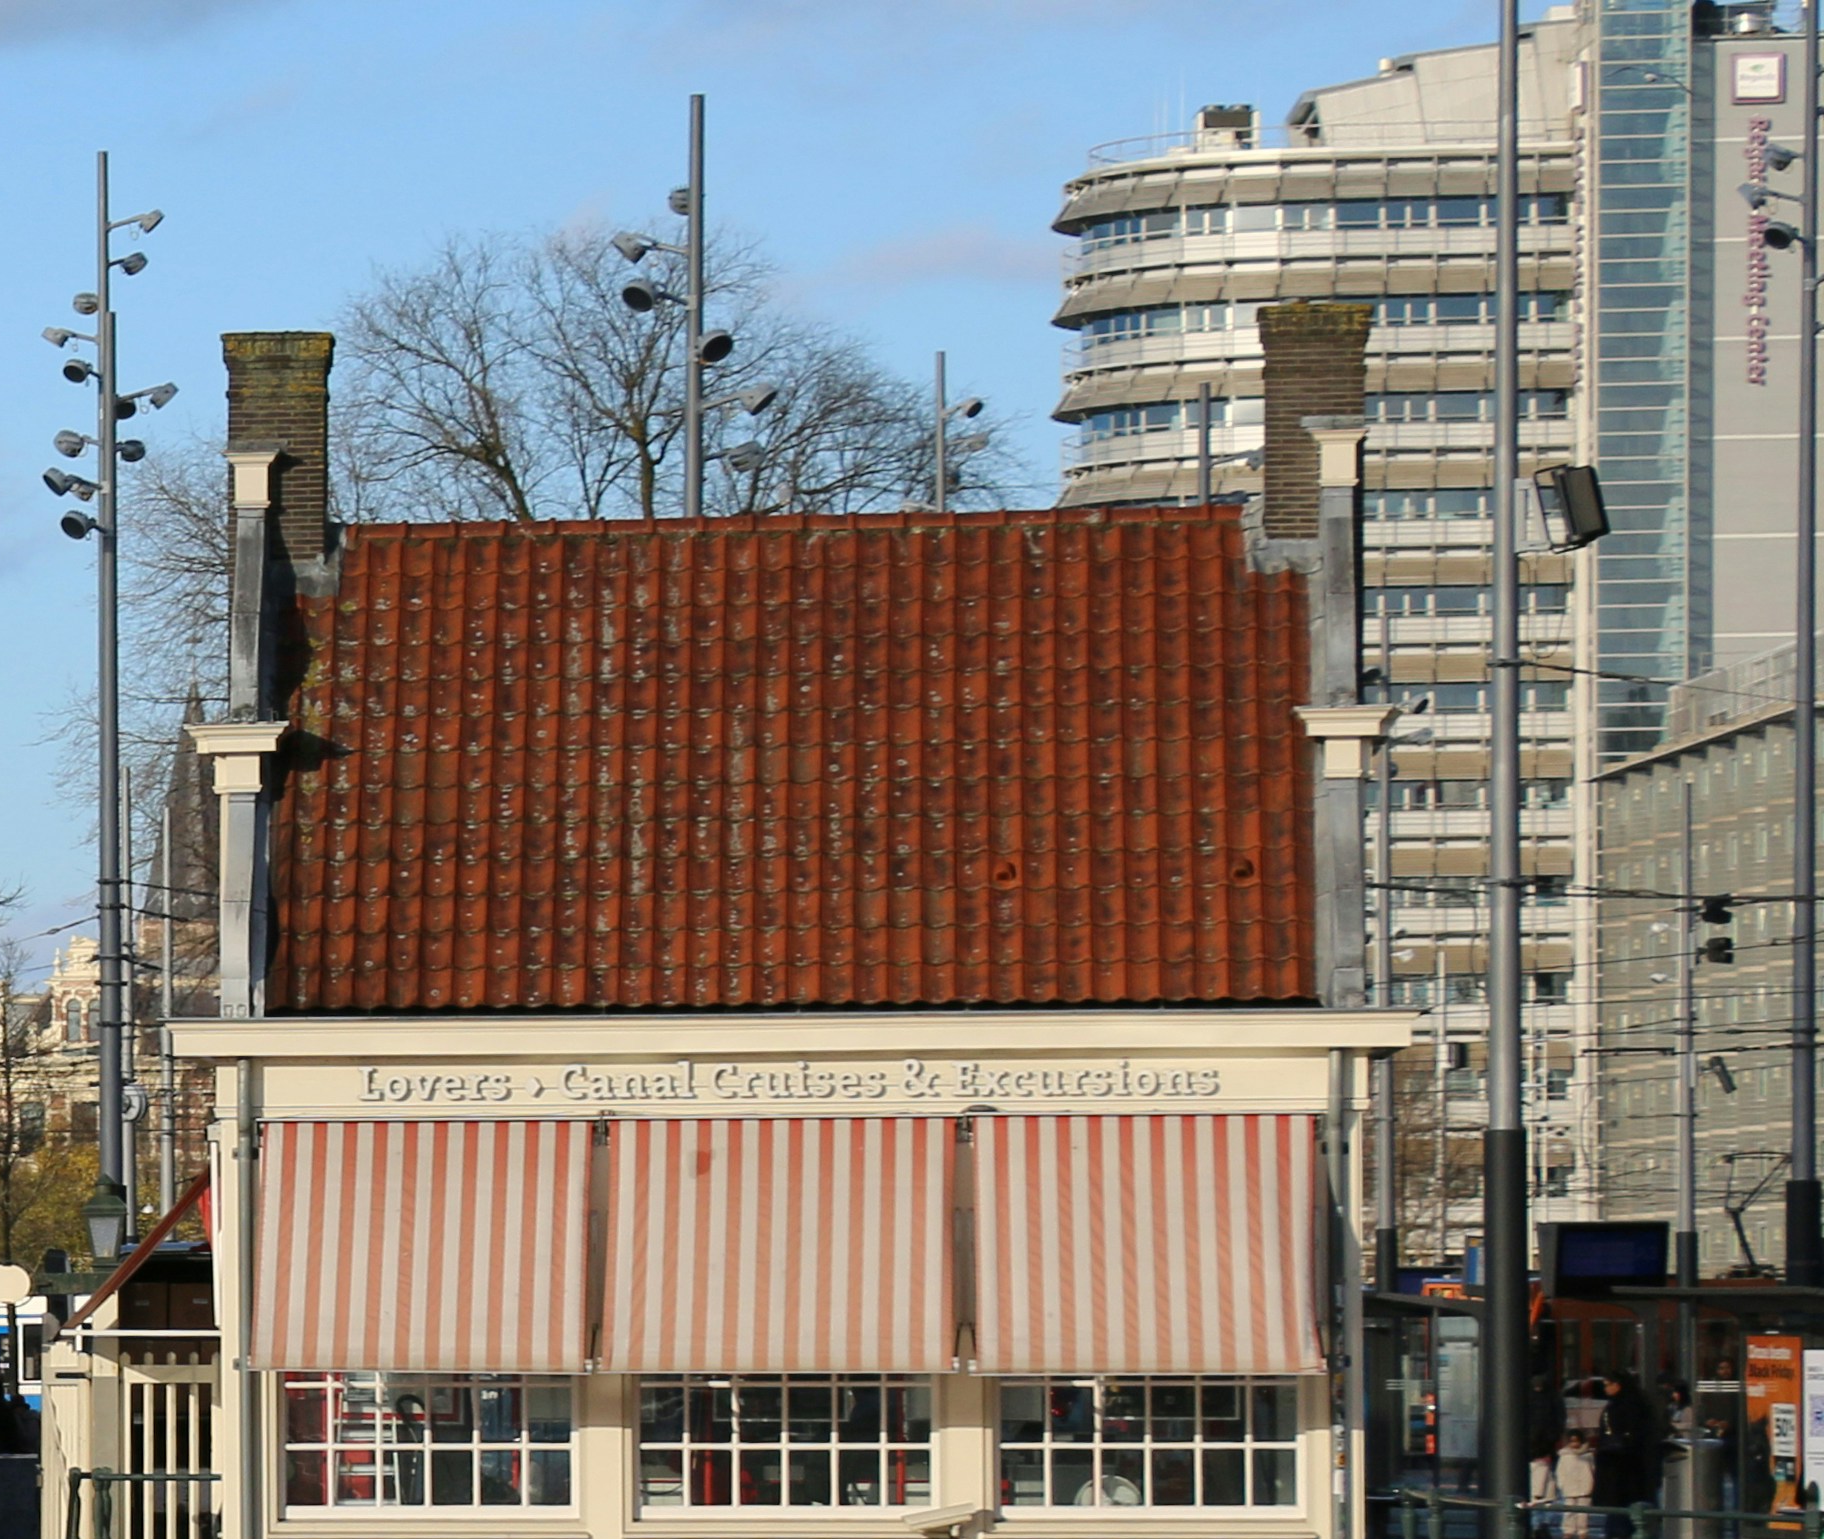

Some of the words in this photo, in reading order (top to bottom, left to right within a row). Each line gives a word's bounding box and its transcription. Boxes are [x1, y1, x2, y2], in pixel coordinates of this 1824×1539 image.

[1746, 316, 1771, 387] Center
[359, 1066, 511, 1101] Lovers
[558, 1060, 697, 1100] Canal
[712, 1060, 887, 1099] Cruises
[901, 1058, 942, 1098] &
[950, 1058, 1221, 1098] Excursions
